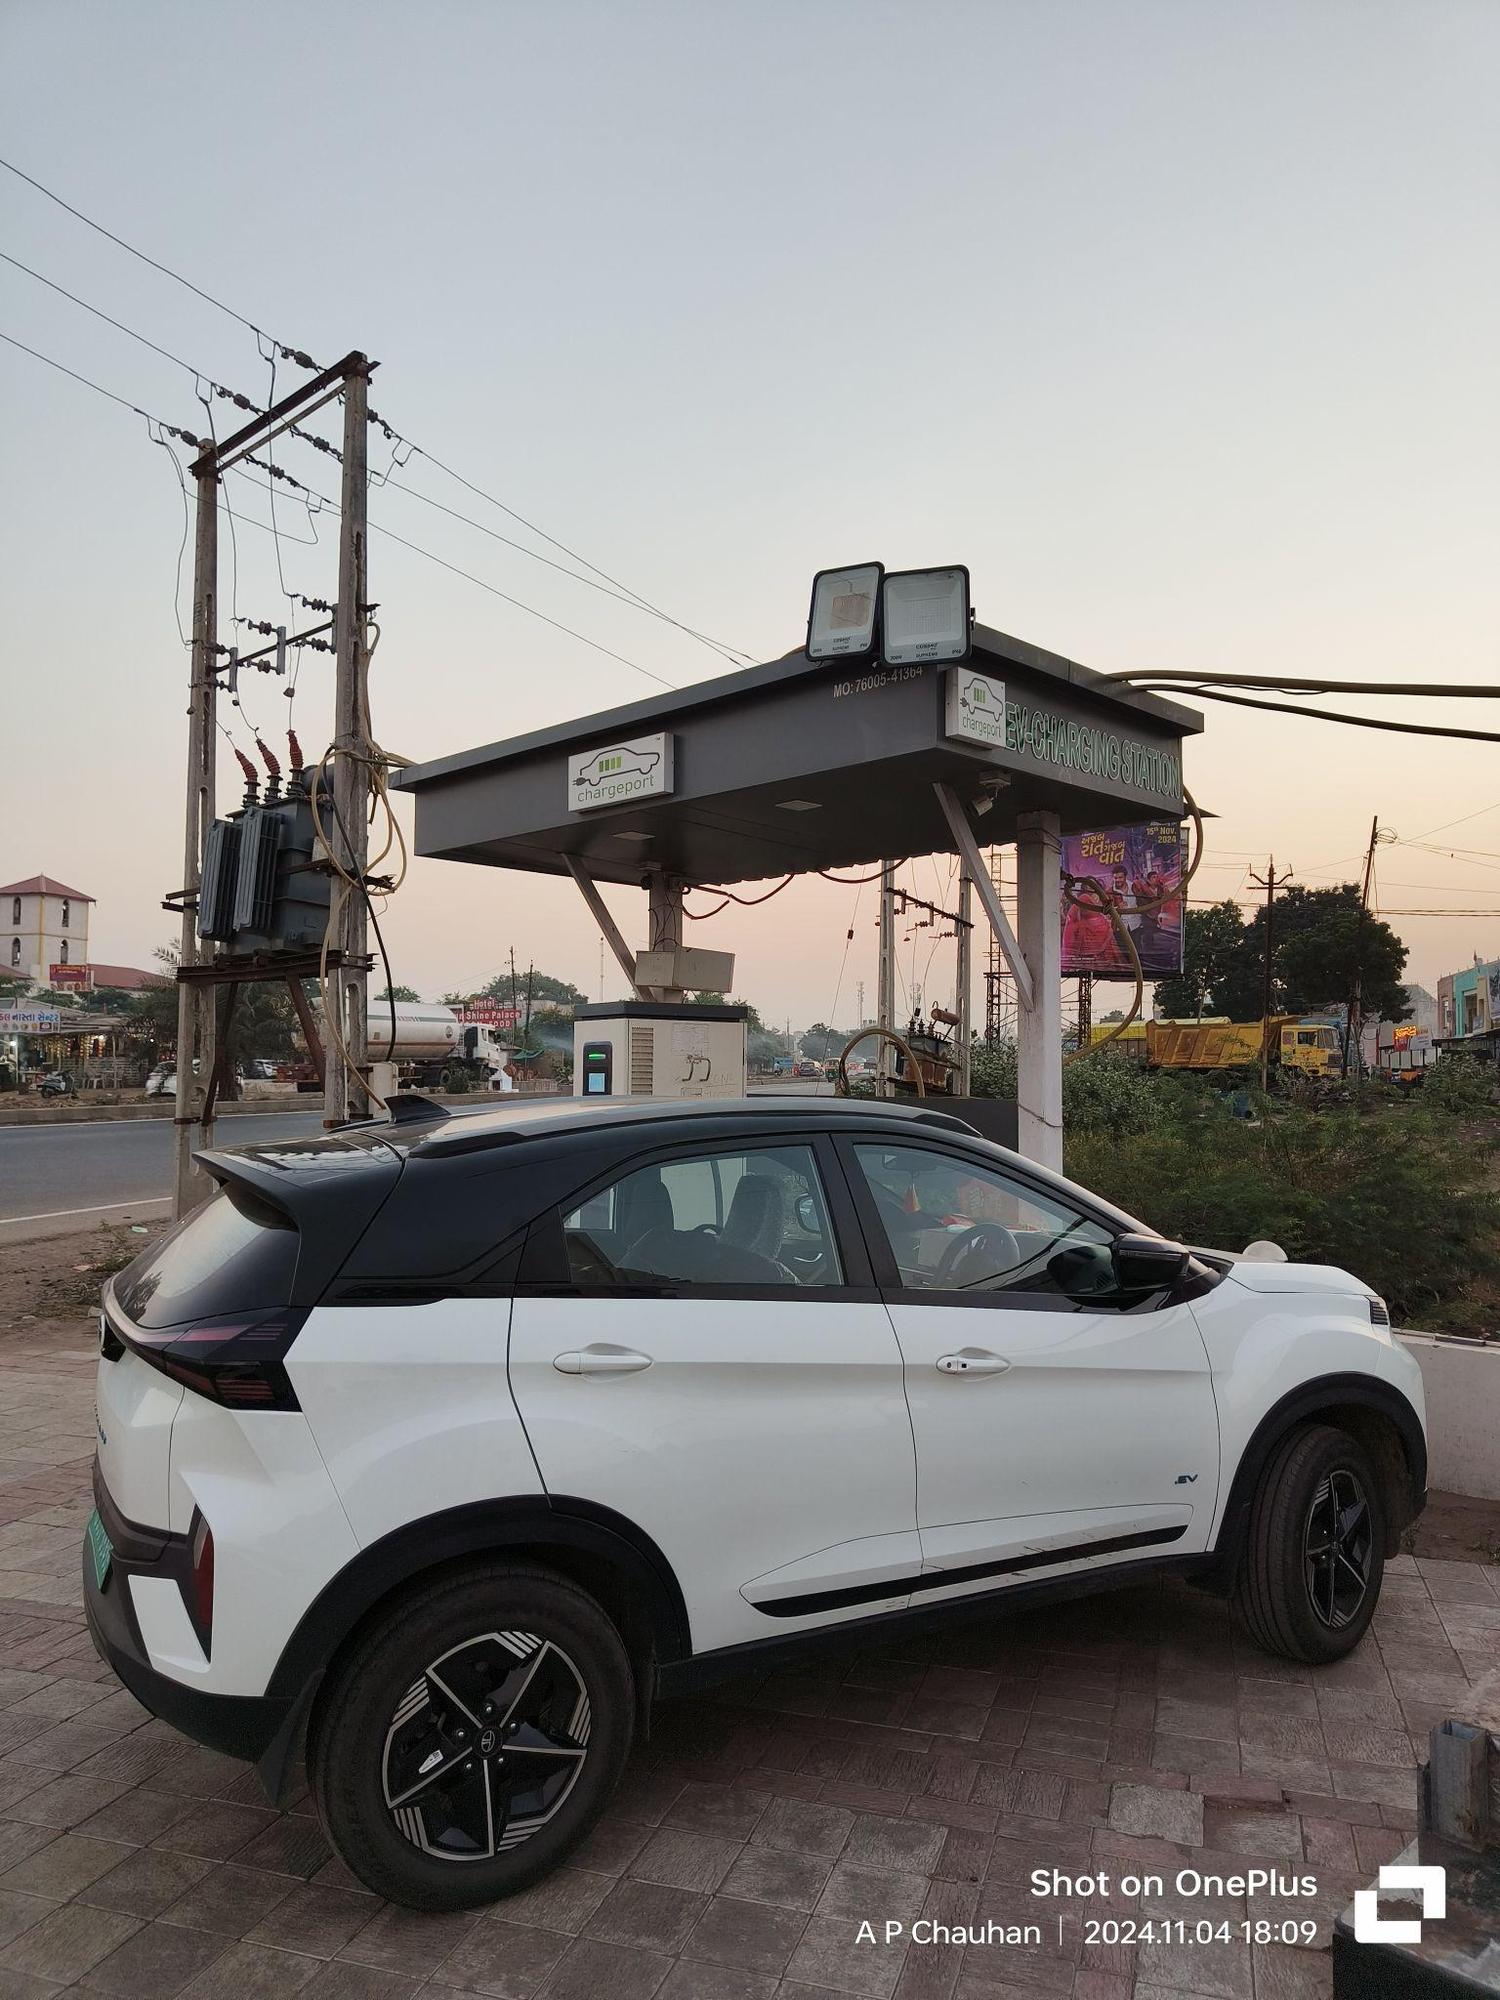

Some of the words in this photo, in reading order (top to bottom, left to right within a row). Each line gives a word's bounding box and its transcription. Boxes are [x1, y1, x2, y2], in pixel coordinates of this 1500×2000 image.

[962, 713, 1002, 741] chargeport
[1121, 739, 1181, 800] STATION
[577, 774, 654, 802] chargeport
[1158, 835, 1177, 844] 2024
[474, 999, 495, 1009] Hotel
[466, 1010, 490, 1020] Shine
[491, 1010, 521, 1020] Palace
